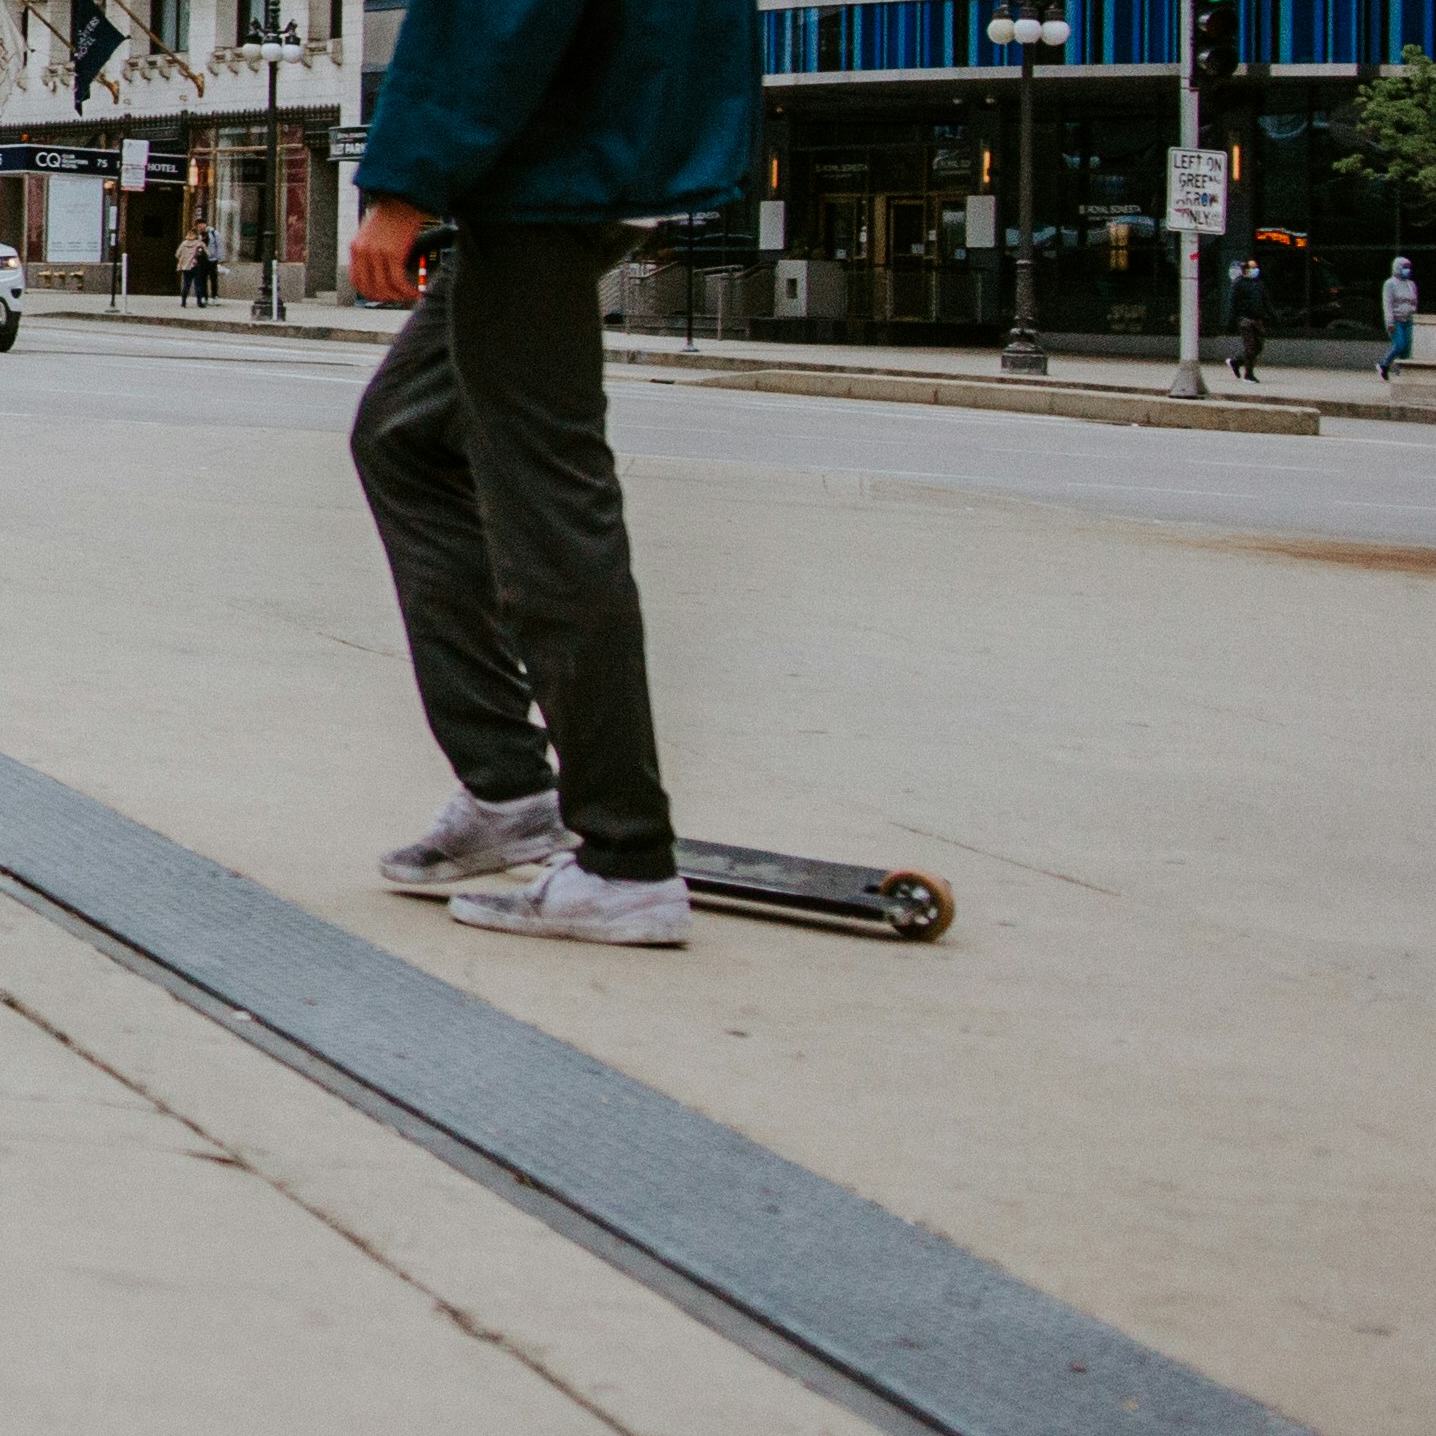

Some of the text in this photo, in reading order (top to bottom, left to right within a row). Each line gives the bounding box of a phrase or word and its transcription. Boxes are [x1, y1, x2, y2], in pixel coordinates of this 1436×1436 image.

[35, 151, 61, 169] CQ
[1174, 154, 1222, 172] LEFT ON
